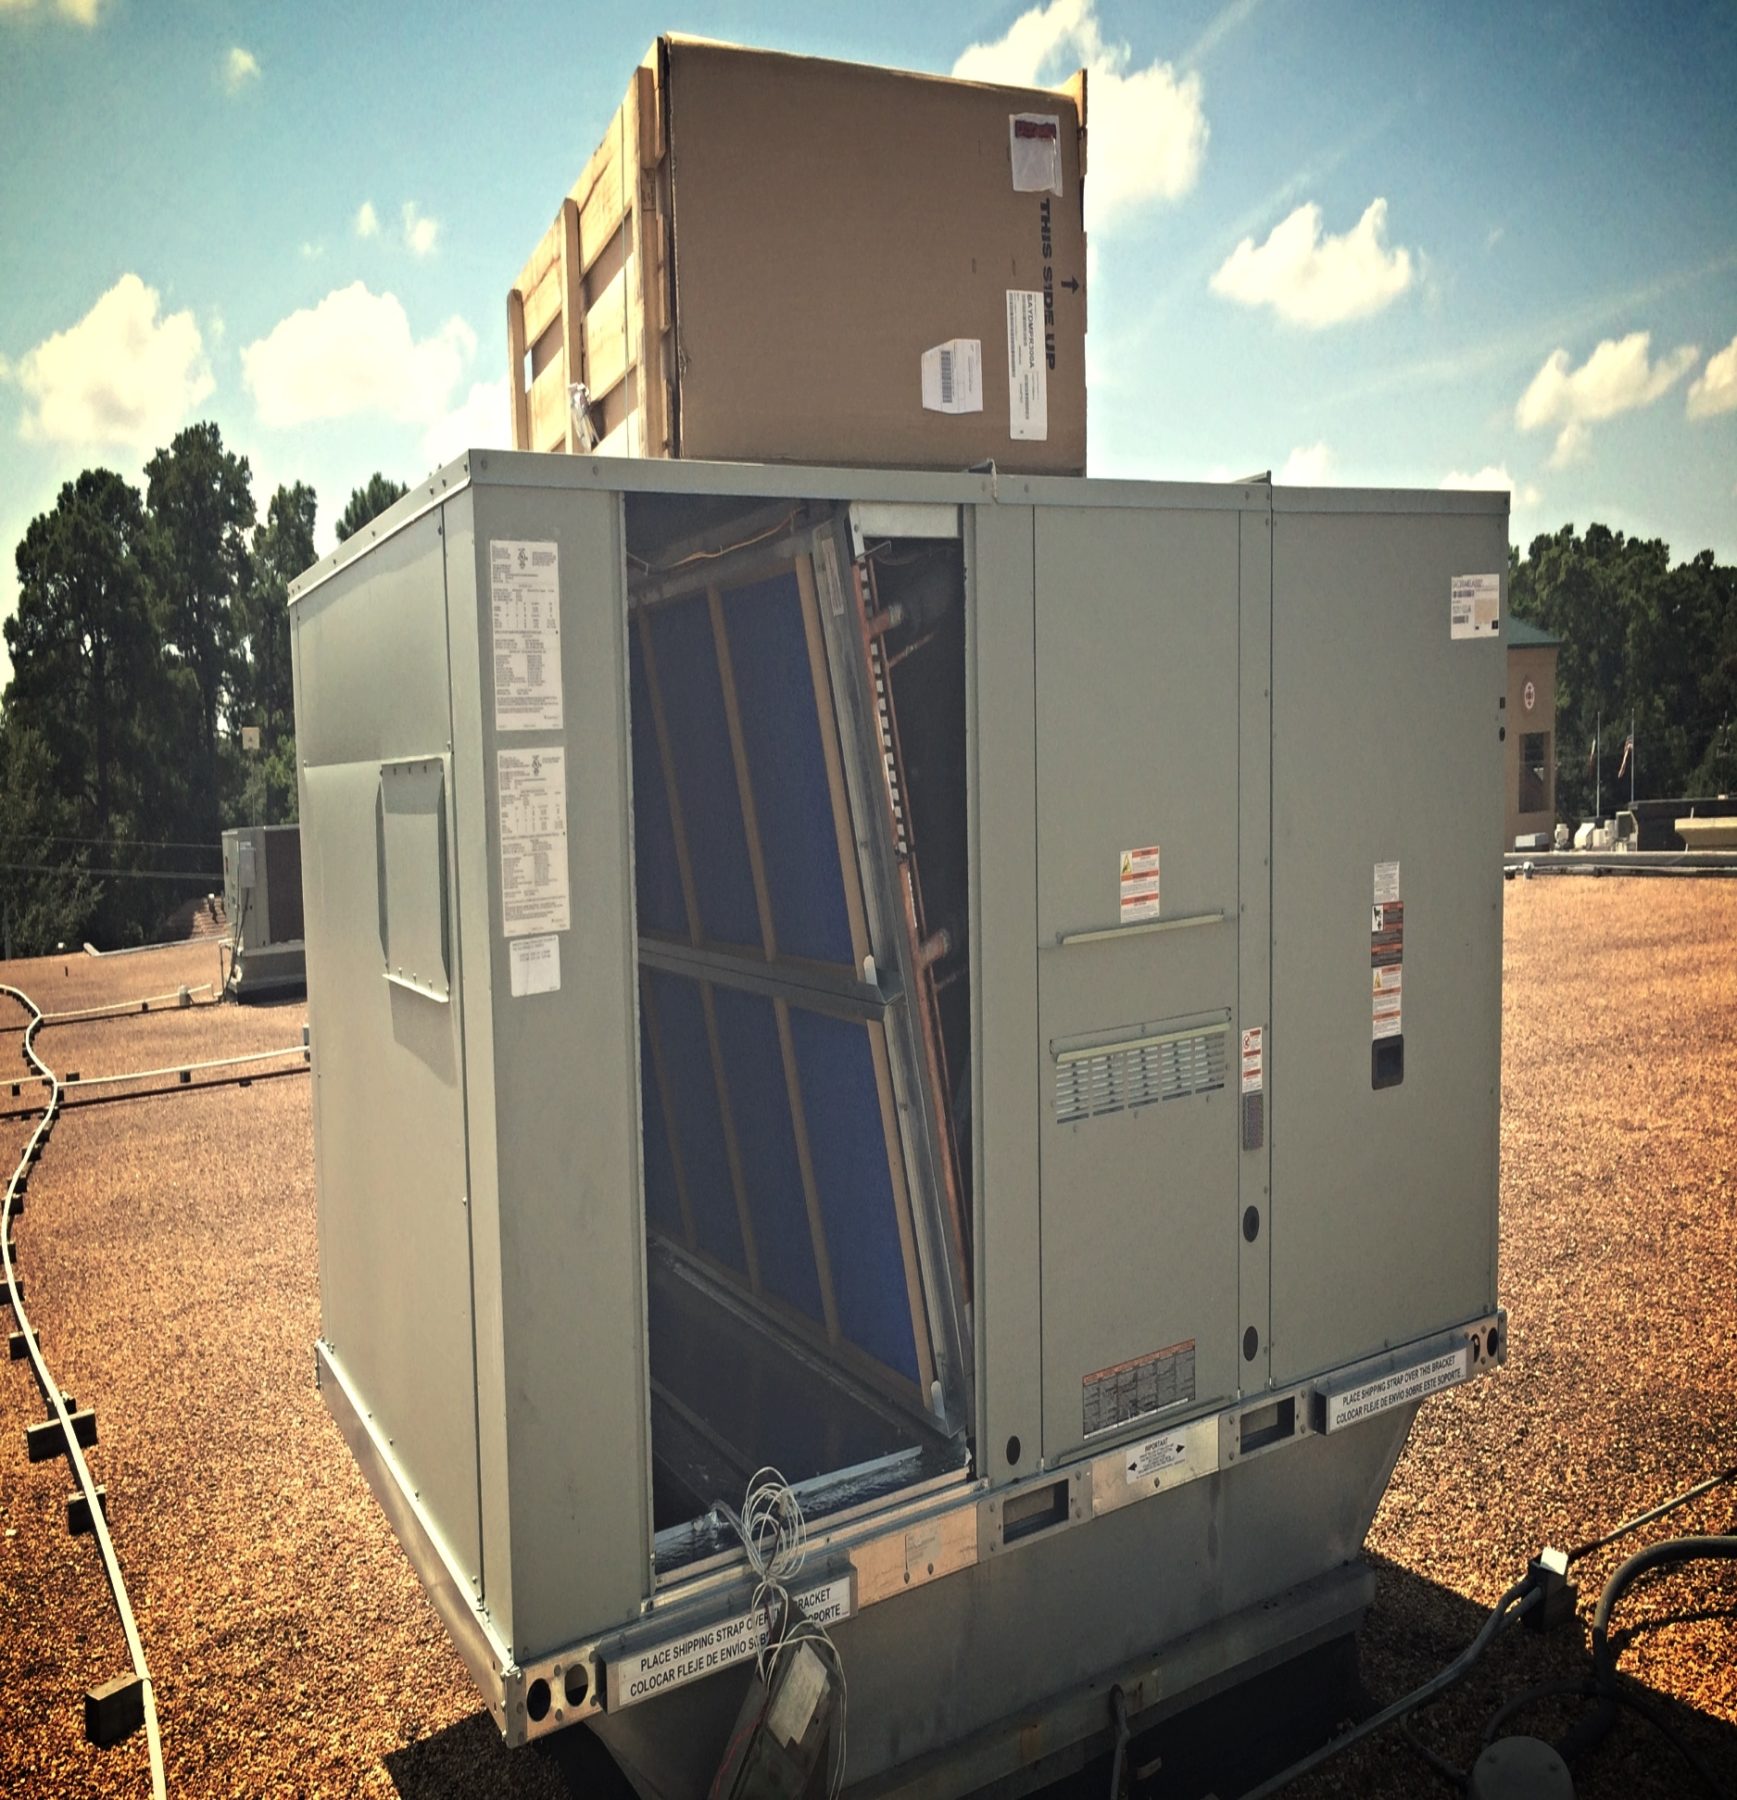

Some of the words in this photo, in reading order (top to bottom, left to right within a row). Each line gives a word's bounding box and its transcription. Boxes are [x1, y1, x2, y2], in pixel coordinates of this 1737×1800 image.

[1040, 197, 1052, 258] THIS
[1043, 266, 1054, 325] SIDE
[1045, 333, 1055, 370] UP
[1336, 1406, 1363, 1424] COLOCAR
[1363, 1399, 1380, 1414] FLEJE
[1380, 1396, 1388, 1408] DE
[1405, 1382, 1423, 1398] SOBRE
[1423, 1377, 1437, 1390] ESTE
[1437, 1368, 1461, 1386] SOPORTE
[1343, 1391, 1360, 1407] PLACE
[1361, 1381, 1386, 1400] SHIPPING
[1387, 1374, 1404, 1390] STRAP
[1404, 1369, 1419, 1383] OVER
[1420, 1364, 1431, 1376] THIS
[1432, 1355, 1455, 1372] BRACKET
[630, 1668, 675, 1697] COLOCAR
[677, 1656, 705, 1679] FLEJE
[706, 1651, 719, 1667] DE
[808, 1603, 841, 1625] PORTE
[640, 1649, 671, 1673] PLACE
[673, 1632, 714, 1660] SHIPPING
[716, 1620, 745, 1642] STRAP
[797, 1587, 831, 1609] RACKET
